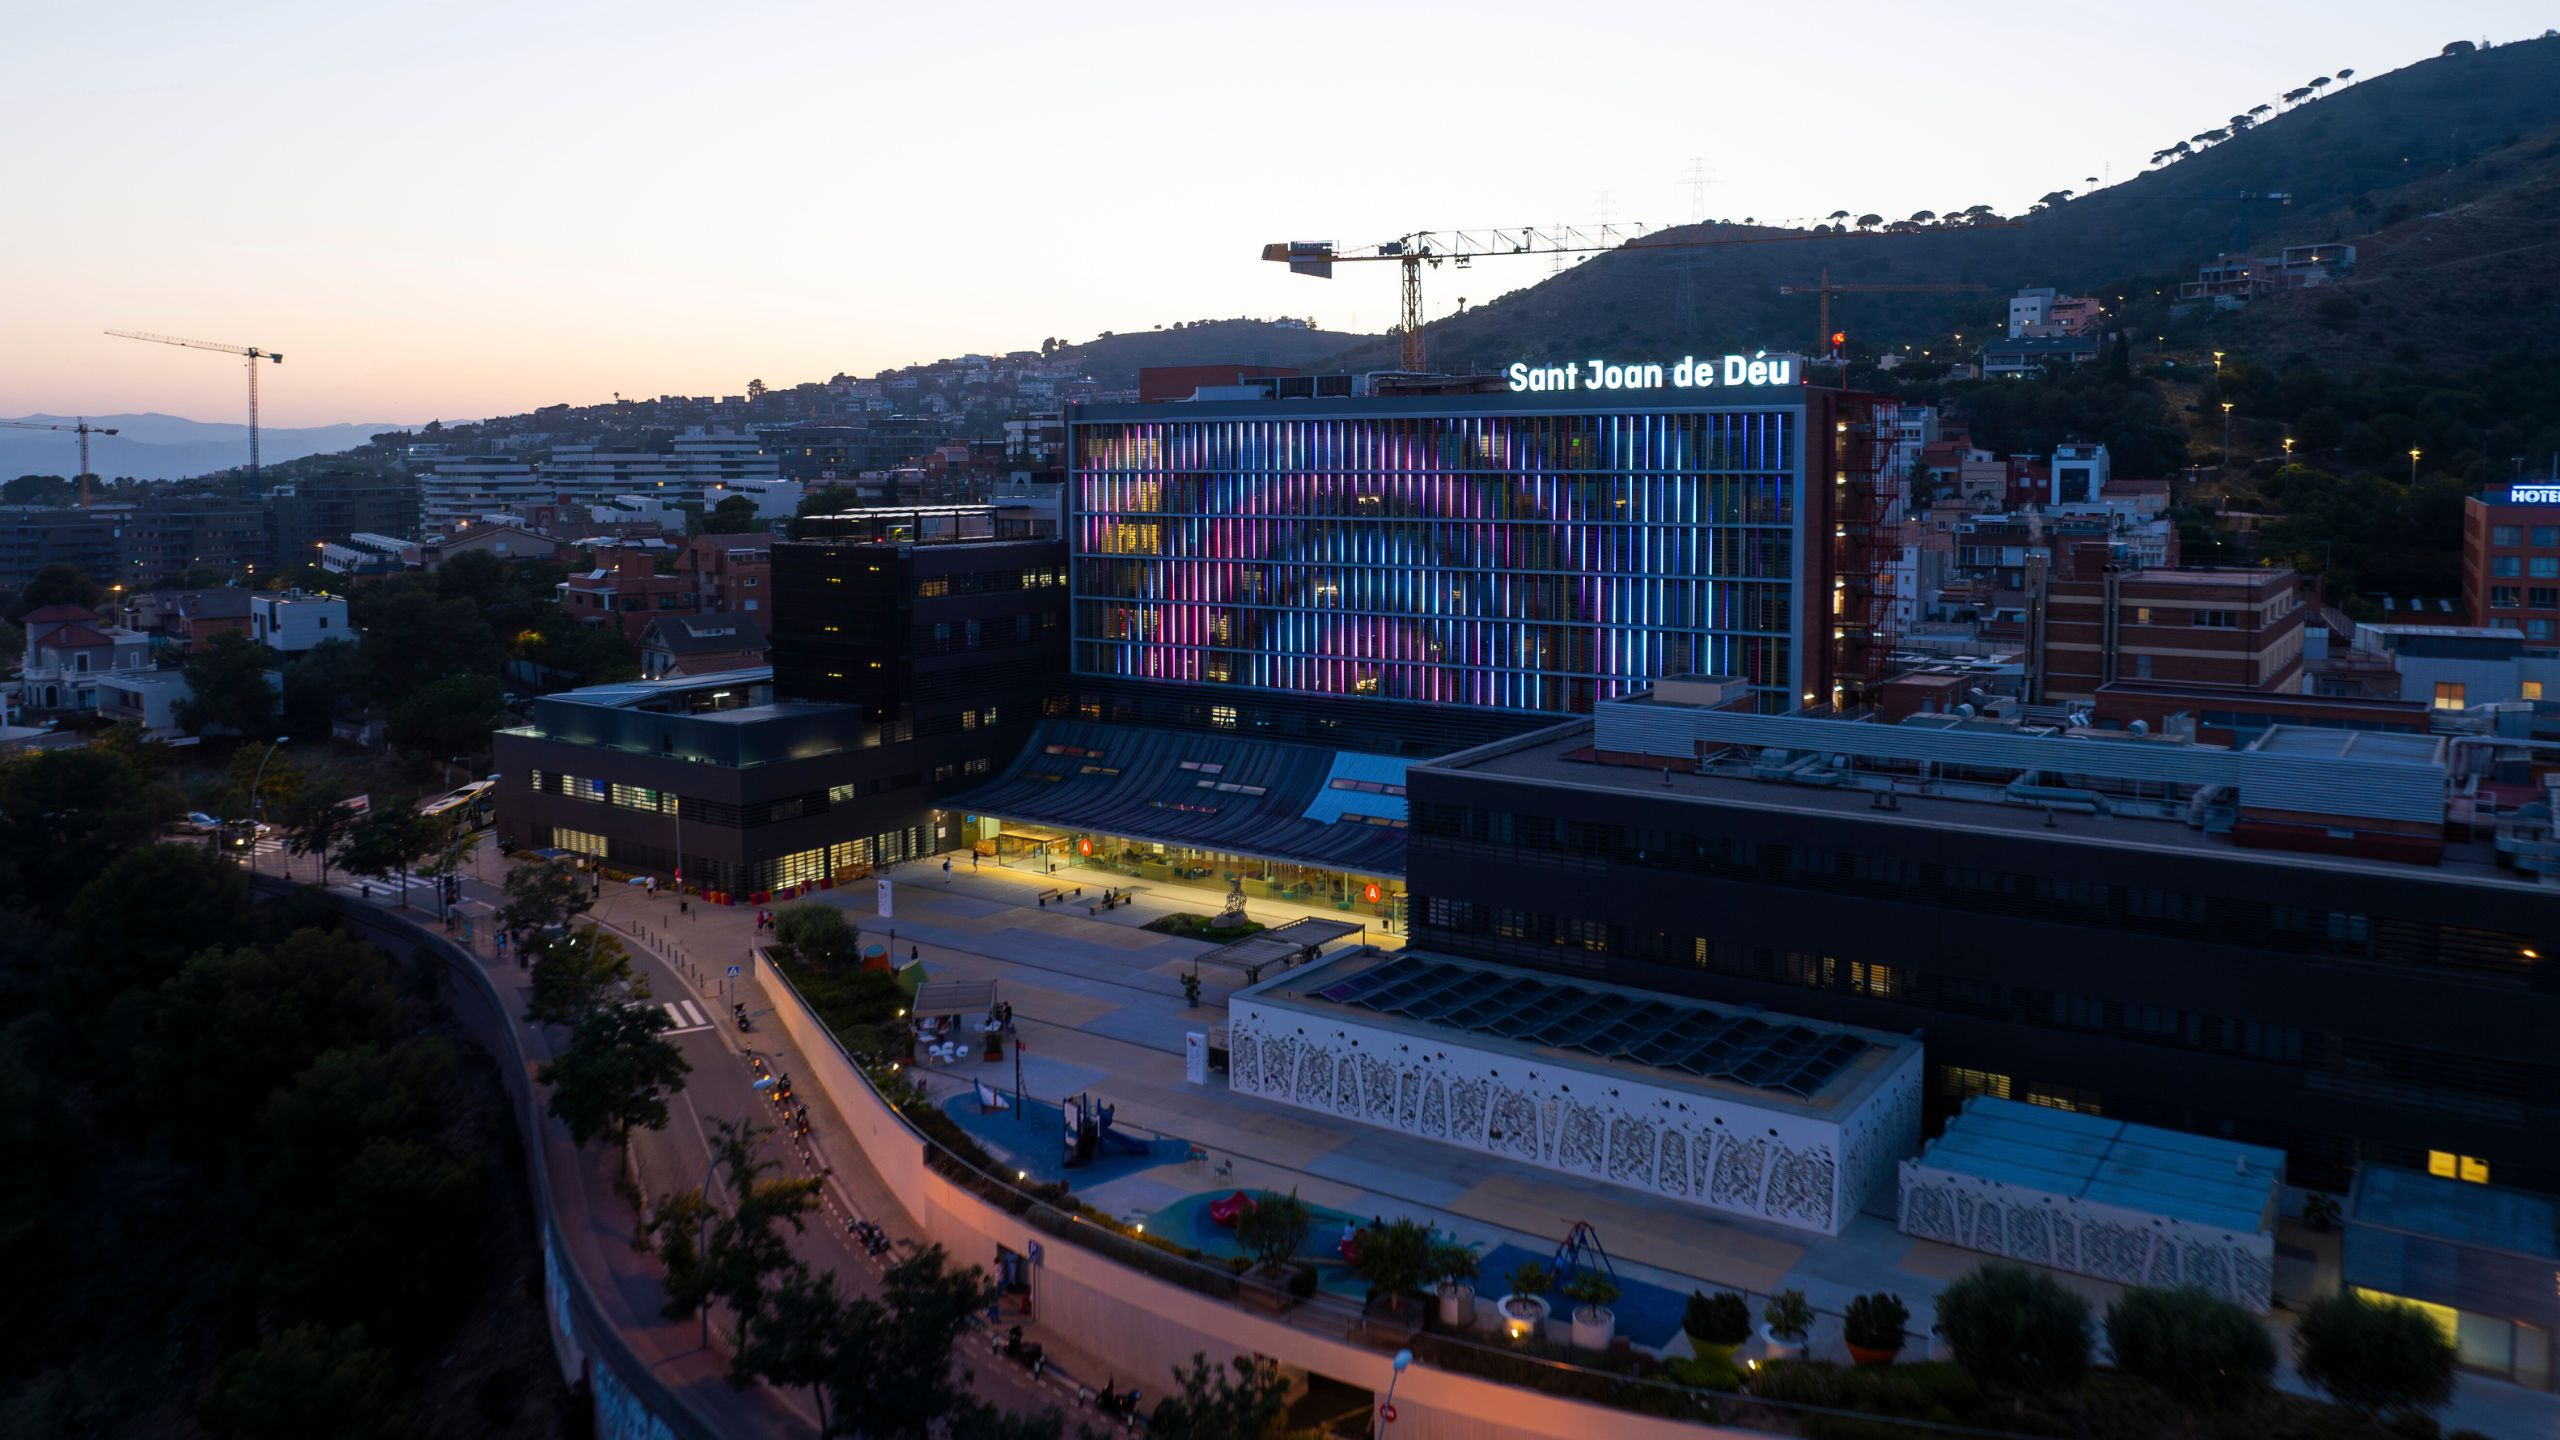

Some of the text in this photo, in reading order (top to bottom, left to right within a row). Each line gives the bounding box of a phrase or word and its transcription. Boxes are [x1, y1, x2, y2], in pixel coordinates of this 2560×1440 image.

[1509, 350, 1790, 391] Sant Joan de Déu
[1082, 842, 1089, 852] A
[1369, 887, 1377, 899] A
